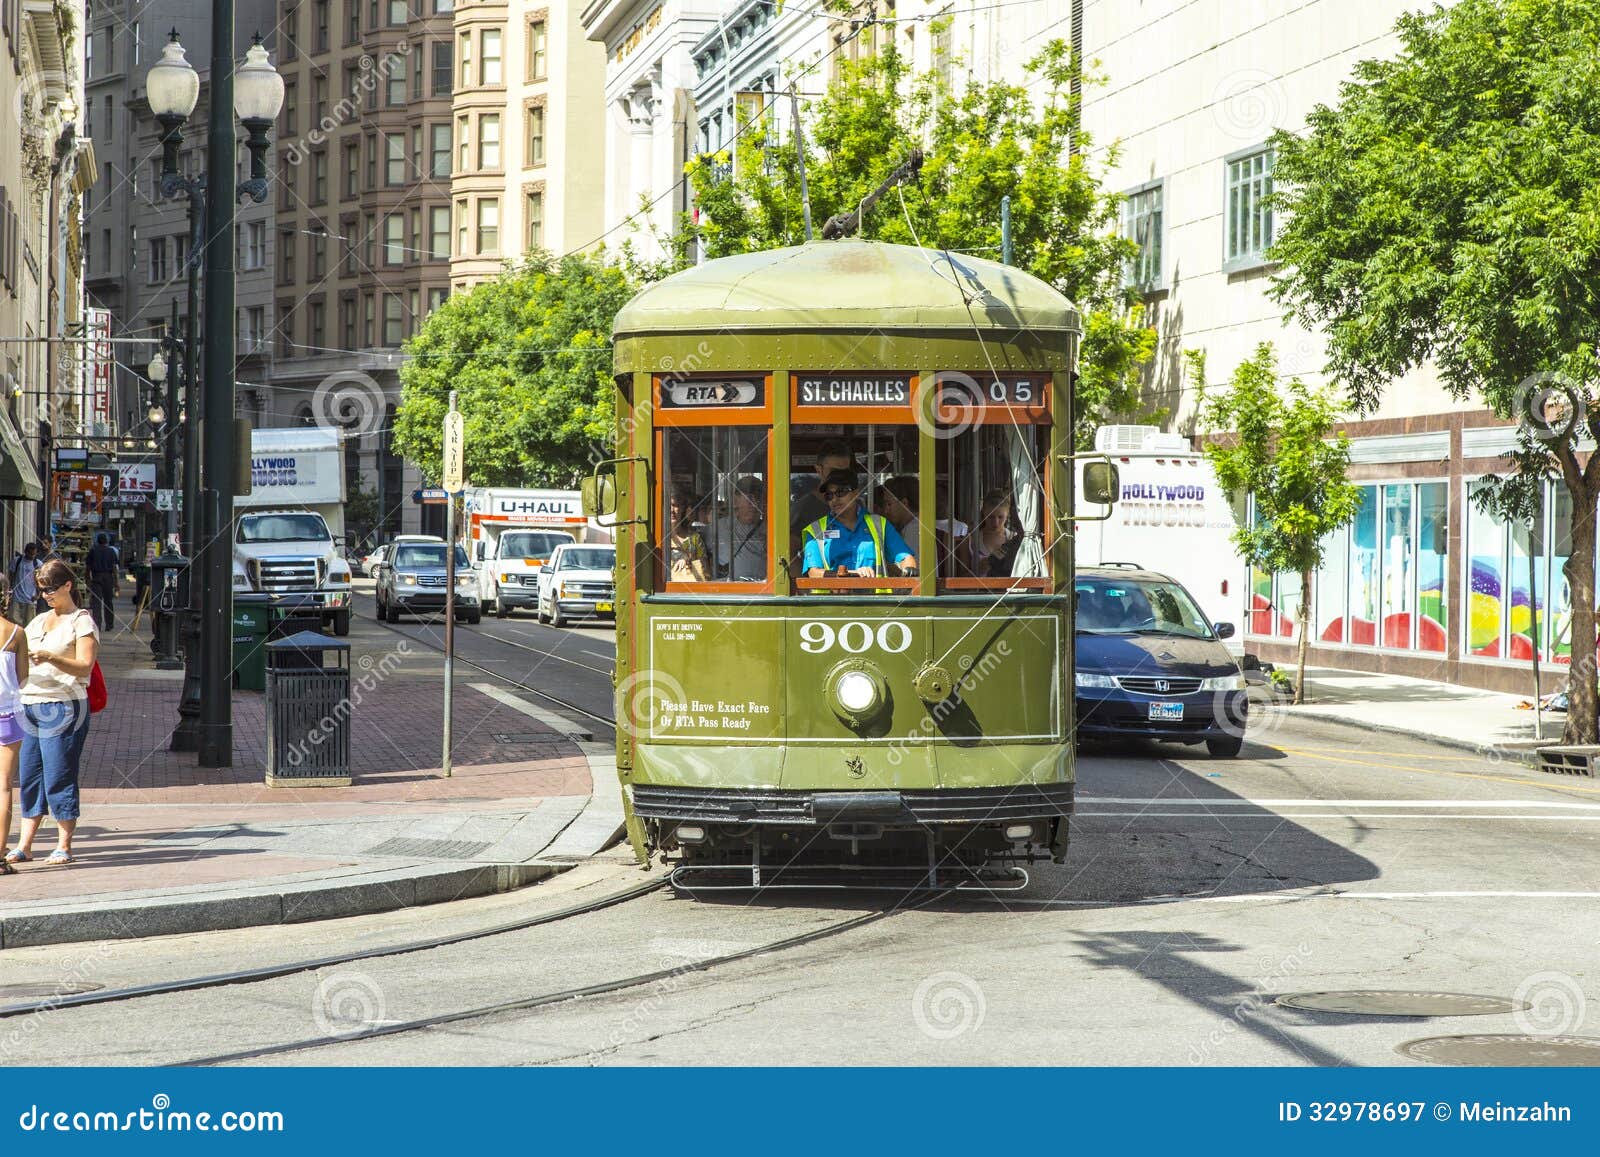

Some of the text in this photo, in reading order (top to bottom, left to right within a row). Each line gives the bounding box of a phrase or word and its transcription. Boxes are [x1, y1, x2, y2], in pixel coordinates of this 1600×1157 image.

[96, 312, 110, 442] BROTHER
[686, 386, 718, 400] RTA
[803, 381, 904, 402] ST. CHARLES
[252, 458, 296, 469] LLYWOOD
[252, 470, 297, 487] UCKS
[1122, 483, 1204, 501] HOLLYWOOD
[501, 501, 574, 514] U-HAUL
[800, 622, 913, 653] 900
[661, 699, 770, 713] Please Have Exact Fare
[661, 716, 752, 730] Or RTA Pass Ready
